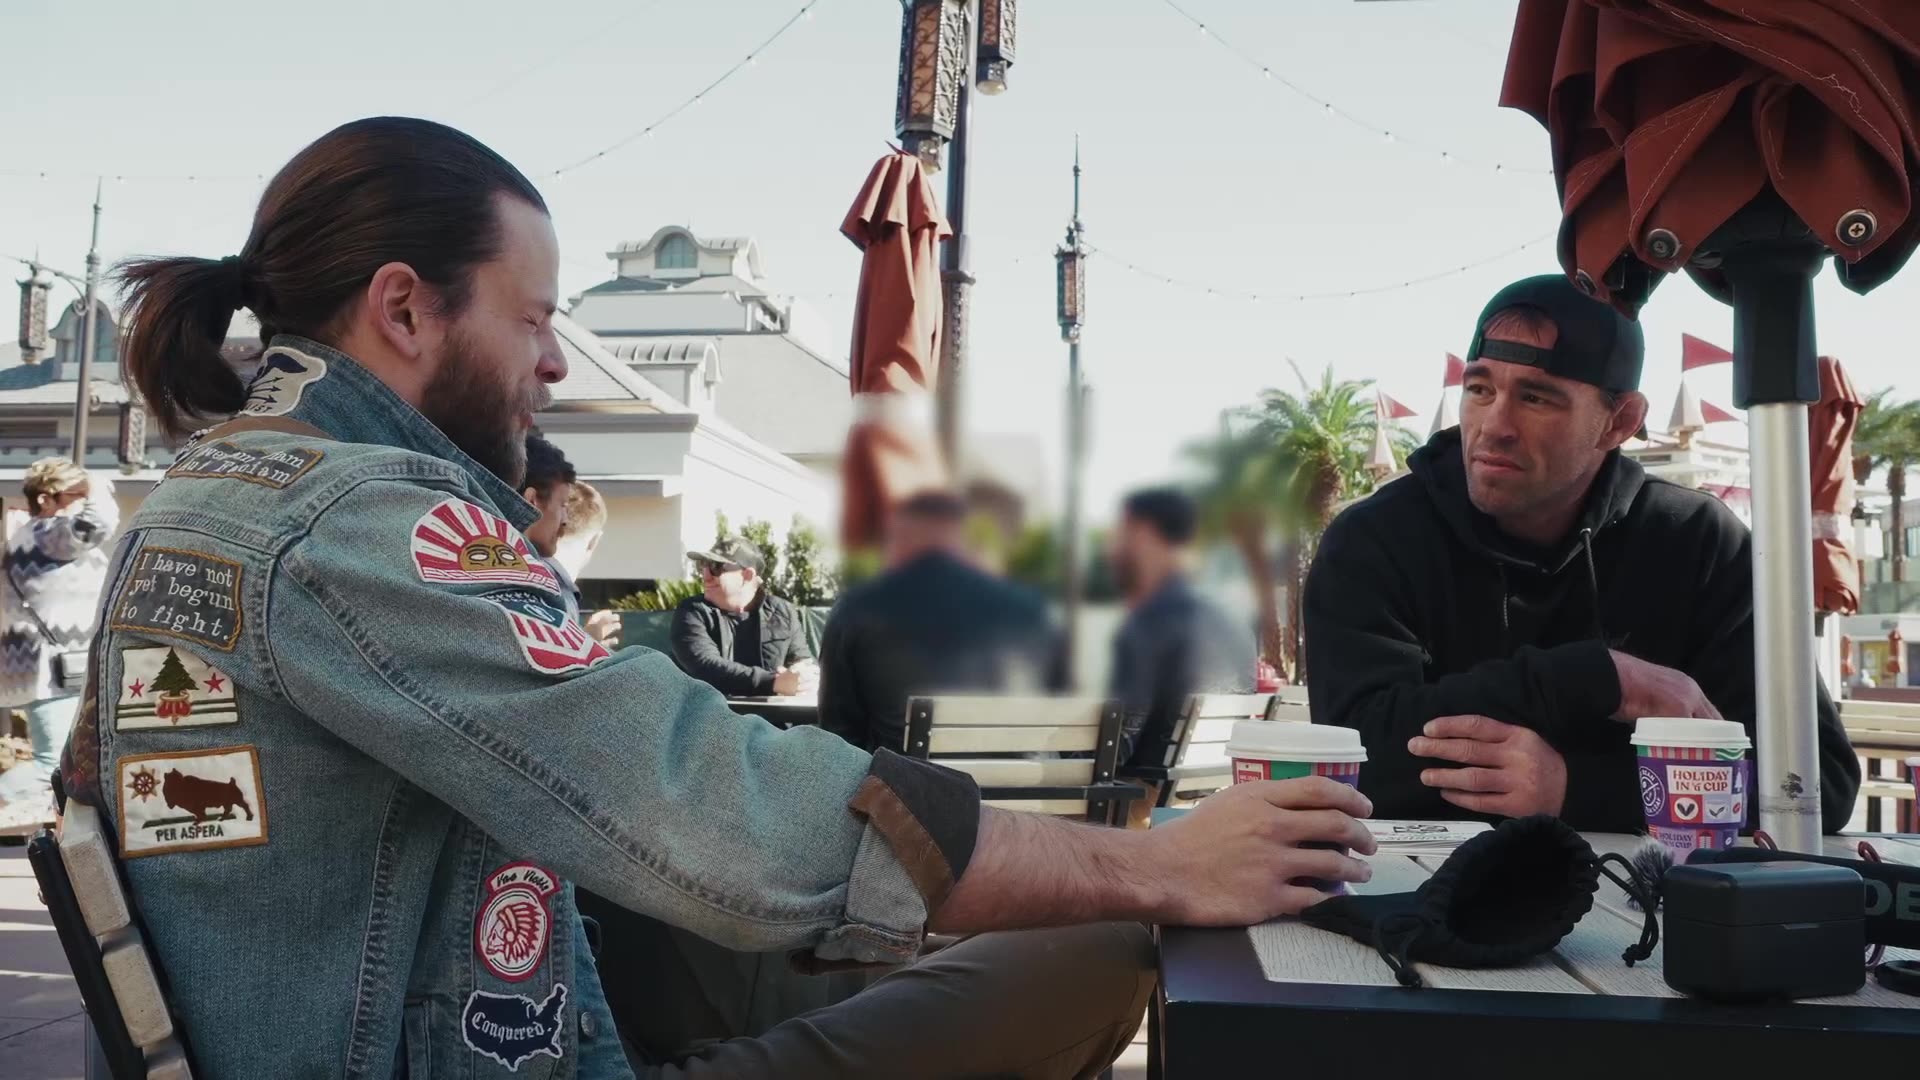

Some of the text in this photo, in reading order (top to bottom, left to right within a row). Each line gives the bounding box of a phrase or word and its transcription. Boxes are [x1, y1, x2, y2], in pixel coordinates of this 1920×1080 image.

[139, 553, 233, 588] I have not
[128, 575, 235, 611] yet begun
[120, 601, 230, 641] to fight.
[1673, 769, 1730, 782] HOLIDAY
[1676, 781, 1690, 791] IN
[1703, 782, 1728, 792] CUP
[155, 825, 224, 842] PER ASPERA
